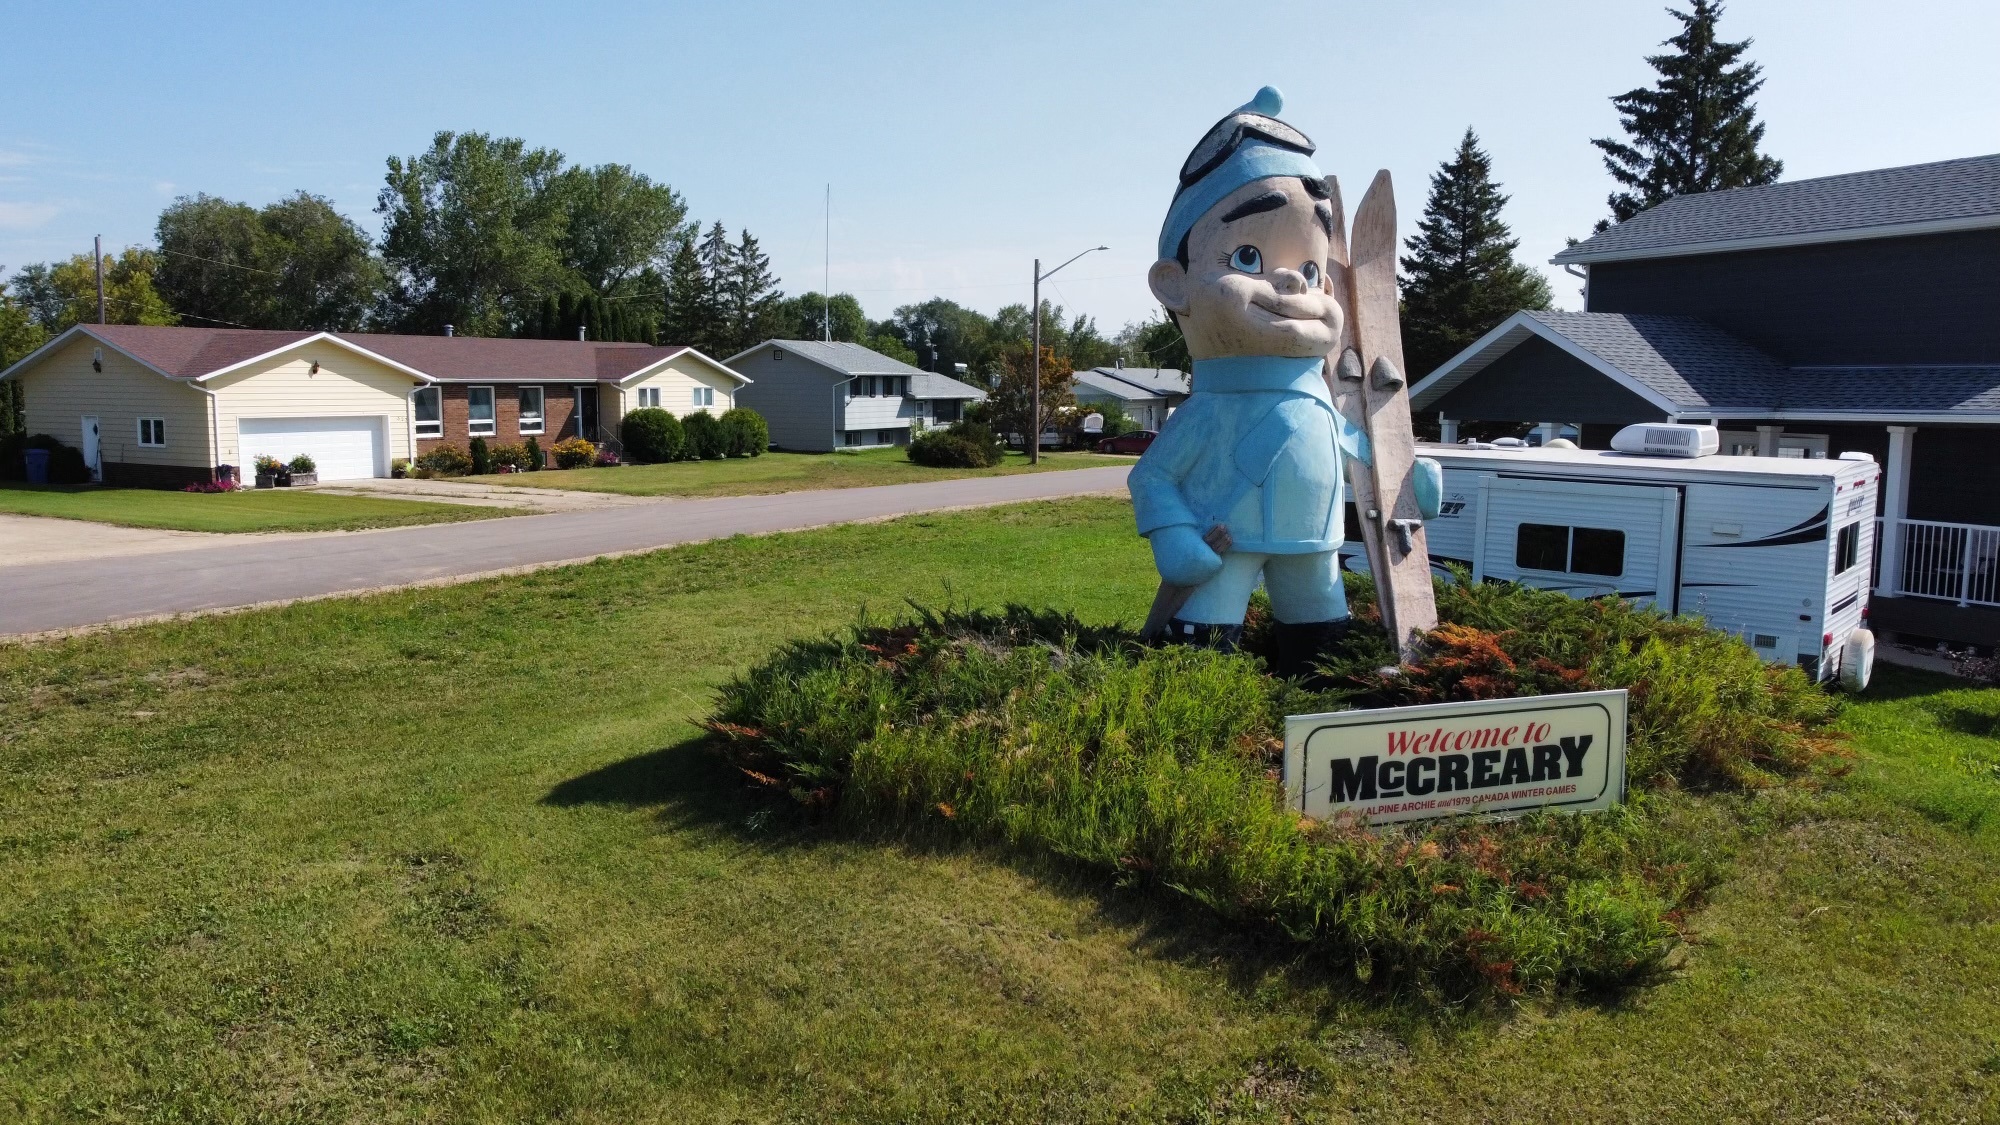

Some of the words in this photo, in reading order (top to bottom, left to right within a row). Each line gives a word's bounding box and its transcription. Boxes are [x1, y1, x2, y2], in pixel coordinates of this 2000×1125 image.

[1388, 726, 1519, 757] Welcome
[1523, 722, 1552, 744] to
[1329, 734, 1593, 803] McCREARY
[1366, 803, 1400, 816] ALPINE
[1401, 800, 1436, 812] ARCHIE
[1437, 799, 1452, 808] and
[1452, 796, 1471, 806] 1979
[1472, 791, 1510, 804] CANADA
[1511, 787, 1545, 800] WINTER
[1546, 784, 1577, 796] GAMES
